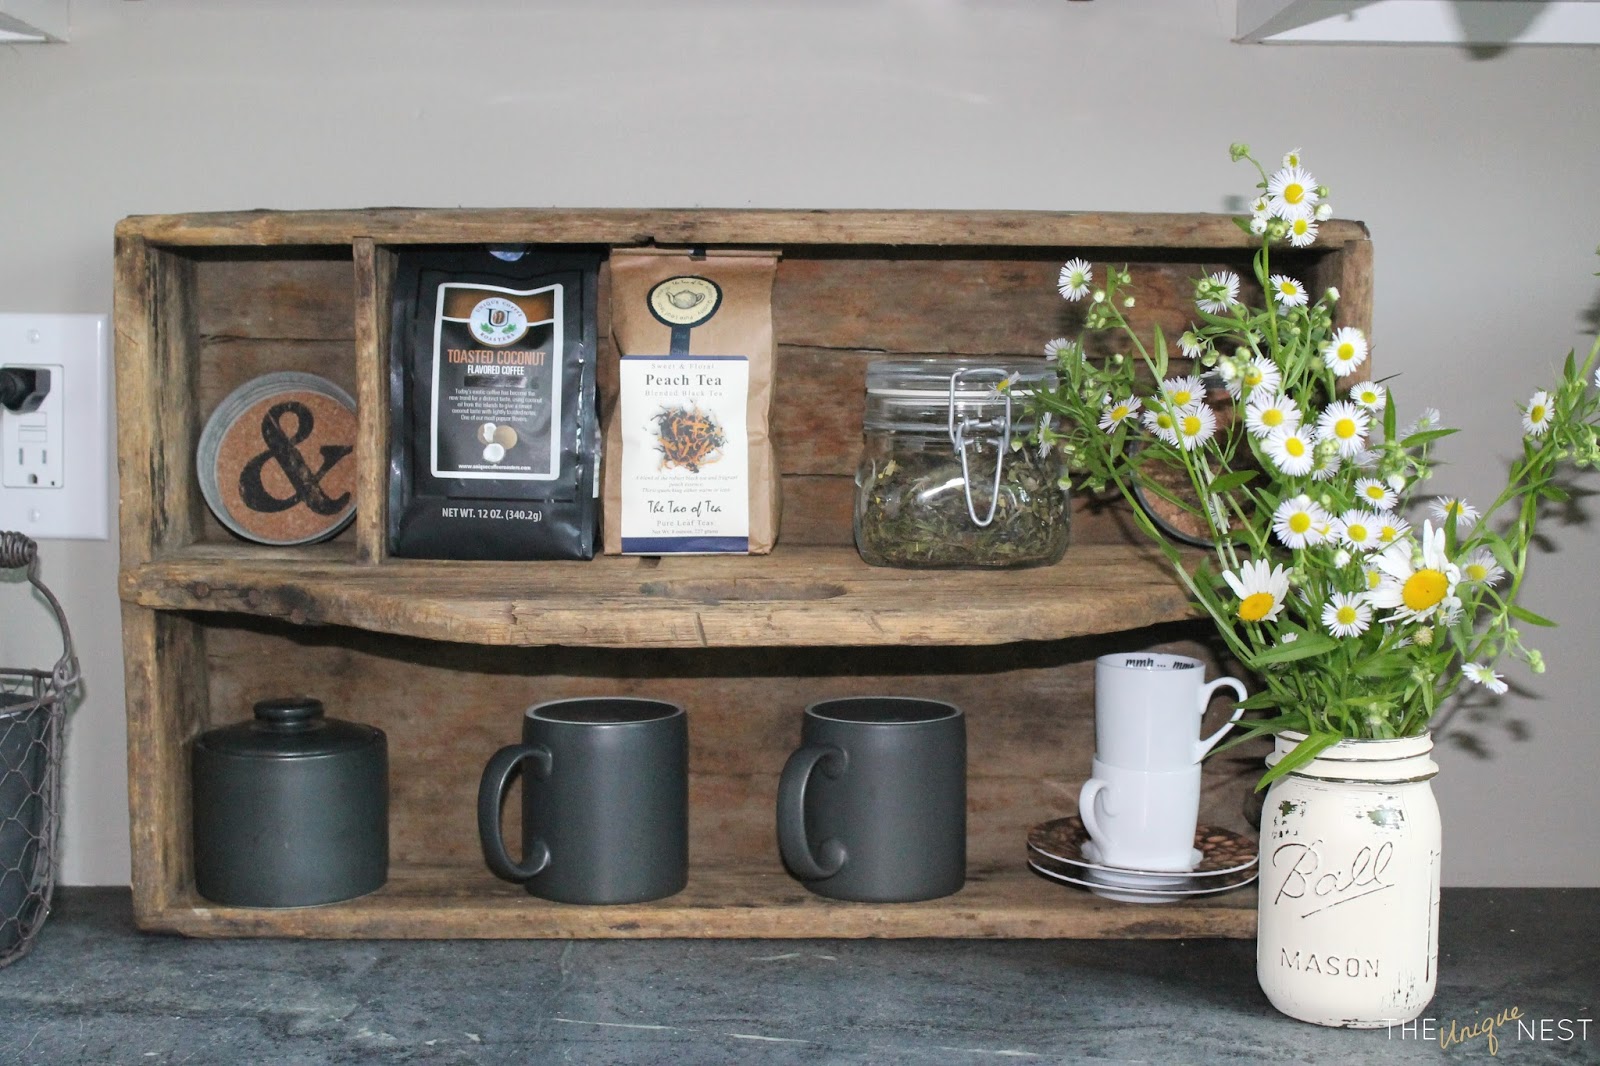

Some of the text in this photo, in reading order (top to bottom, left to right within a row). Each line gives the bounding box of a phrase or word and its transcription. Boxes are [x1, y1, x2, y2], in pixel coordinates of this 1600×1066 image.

[476, 300, 522, 318] UNIQUE COFFEE
[480, 332, 515, 342] ROASTERS
[448, 349, 546, 366] TOASTED COCONUT
[468, 364, 525, 376] FLAVORED COFFEE
[645, 374, 722, 386] Peach Tea
[239, 401, 353, 516] &
[442, 508, 542, 522] NET WT. 12 OZ. (340.2g)
[648, 500, 722, 518] The Tao of Tea
[1126, 658, 1154, 667] mmh
[1273, 840, 1394, 905] Ball
[1281, 948, 1379, 978] MASON
